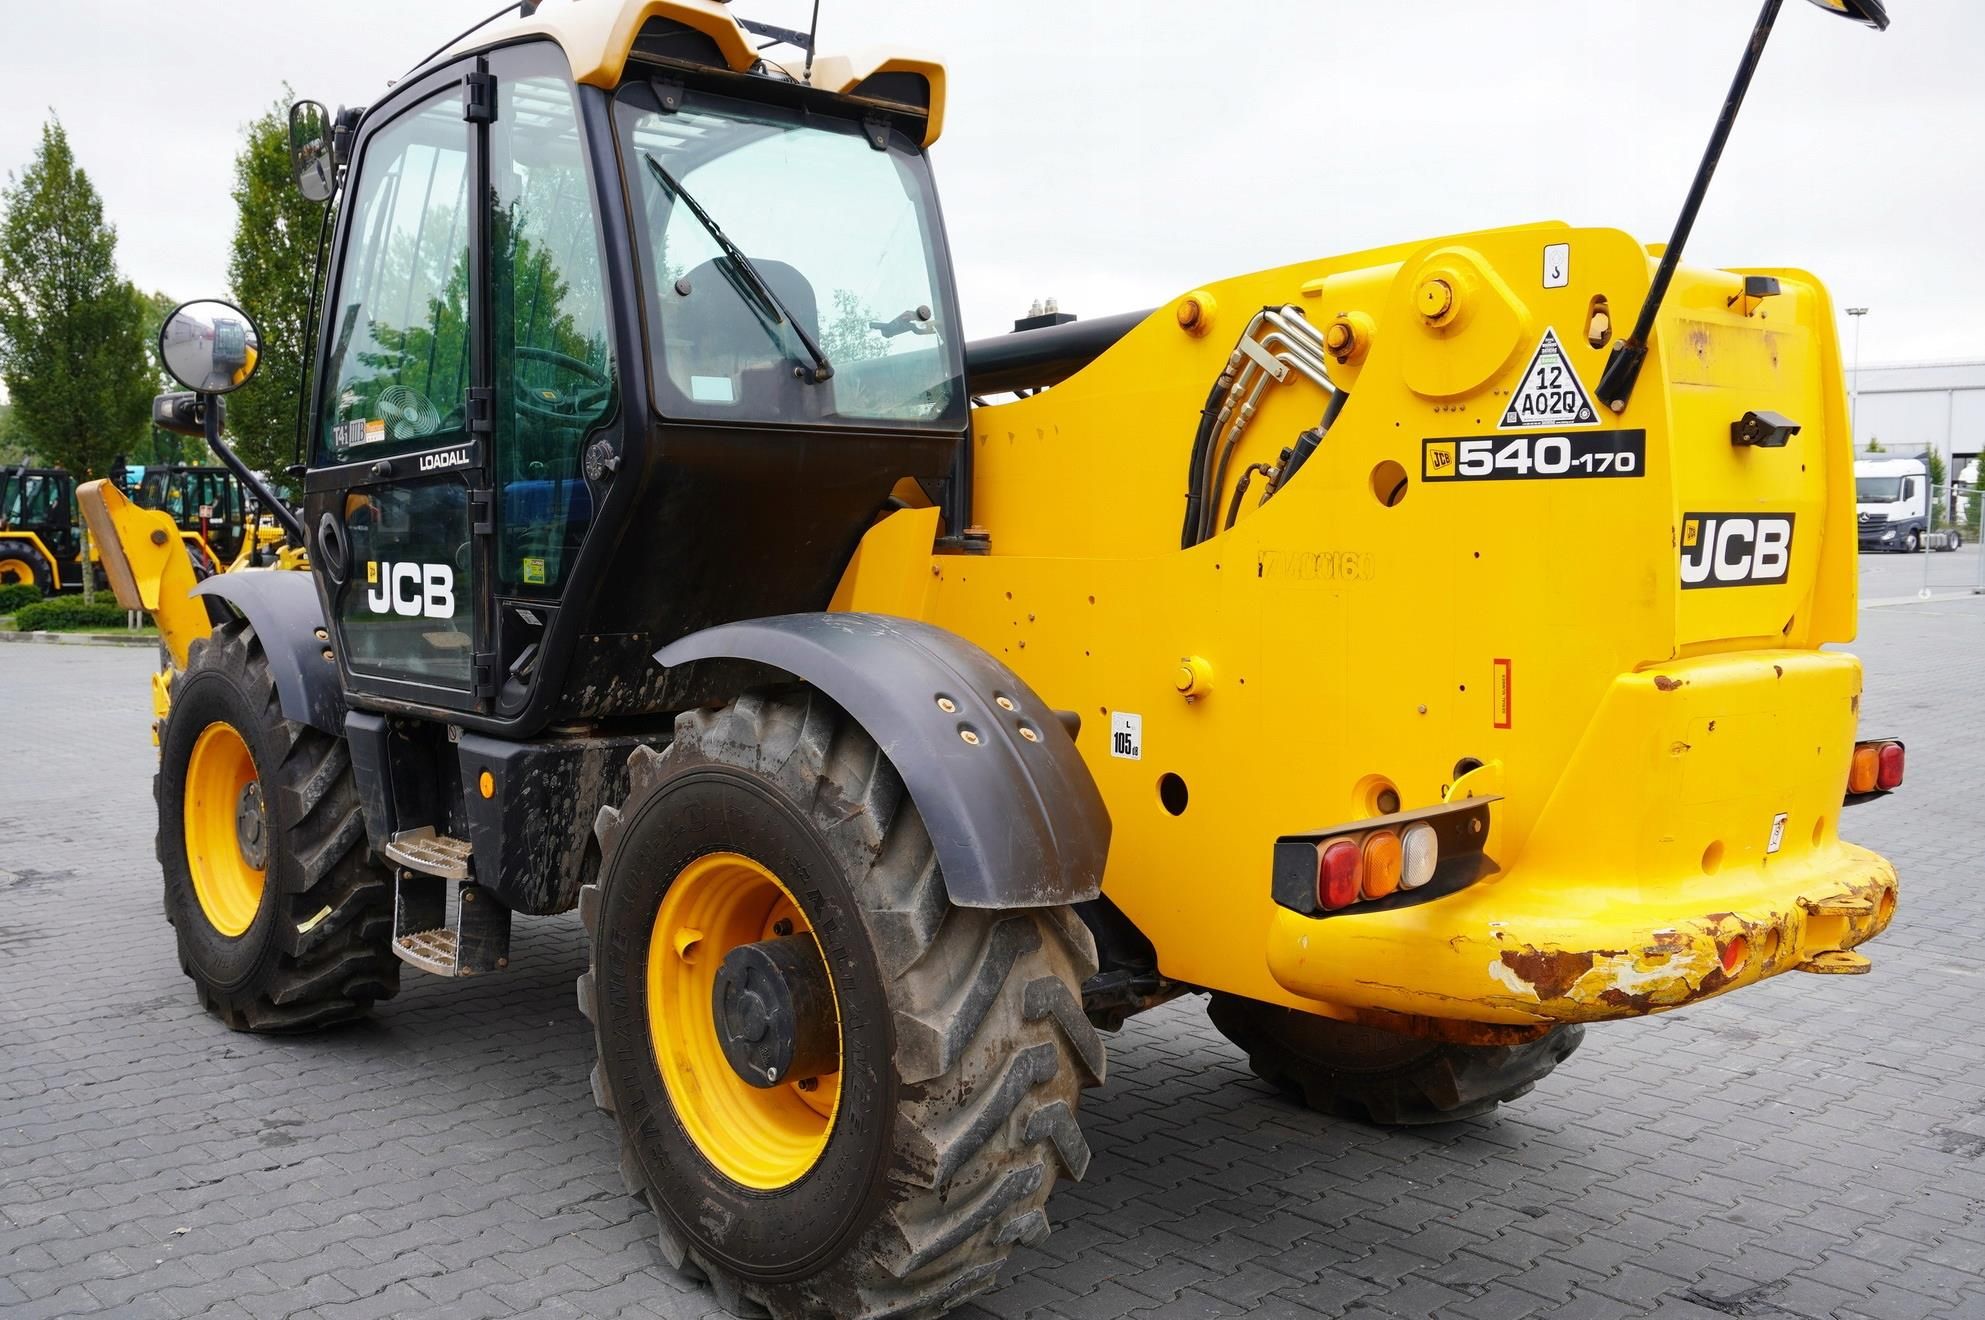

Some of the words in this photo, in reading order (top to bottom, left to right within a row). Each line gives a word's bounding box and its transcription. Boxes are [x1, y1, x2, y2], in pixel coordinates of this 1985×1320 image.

[1536, 366, 1562, 390] 12
[419, 450, 470, 471] LOADALL
[1431, 449, 1451, 471] JCB
[1458, 436, 1636, 476] 540-170
[1680, 518, 1791, 583] JCB
[367, 561, 455, 619] JCB
[1114, 732, 1131, 754] 105
